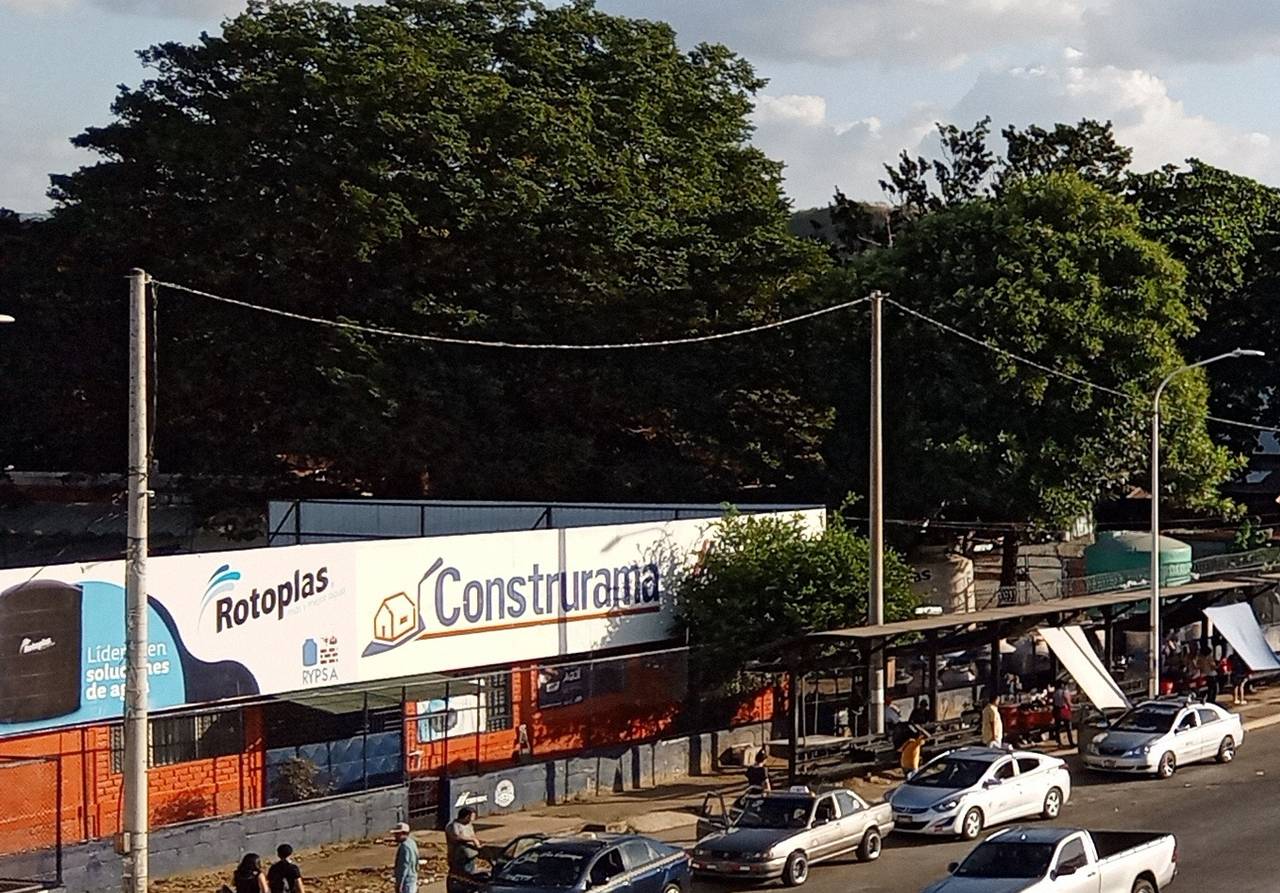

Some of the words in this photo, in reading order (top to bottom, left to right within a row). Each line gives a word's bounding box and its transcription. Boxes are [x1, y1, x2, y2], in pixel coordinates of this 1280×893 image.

[215, 566, 329, 634] Rotoplas
[435, 563, 660, 627] Construrama
[86, 660, 170, 682] solucnes
[303, 667, 338, 685] RYPSA
[86, 682, 107, 700] de
